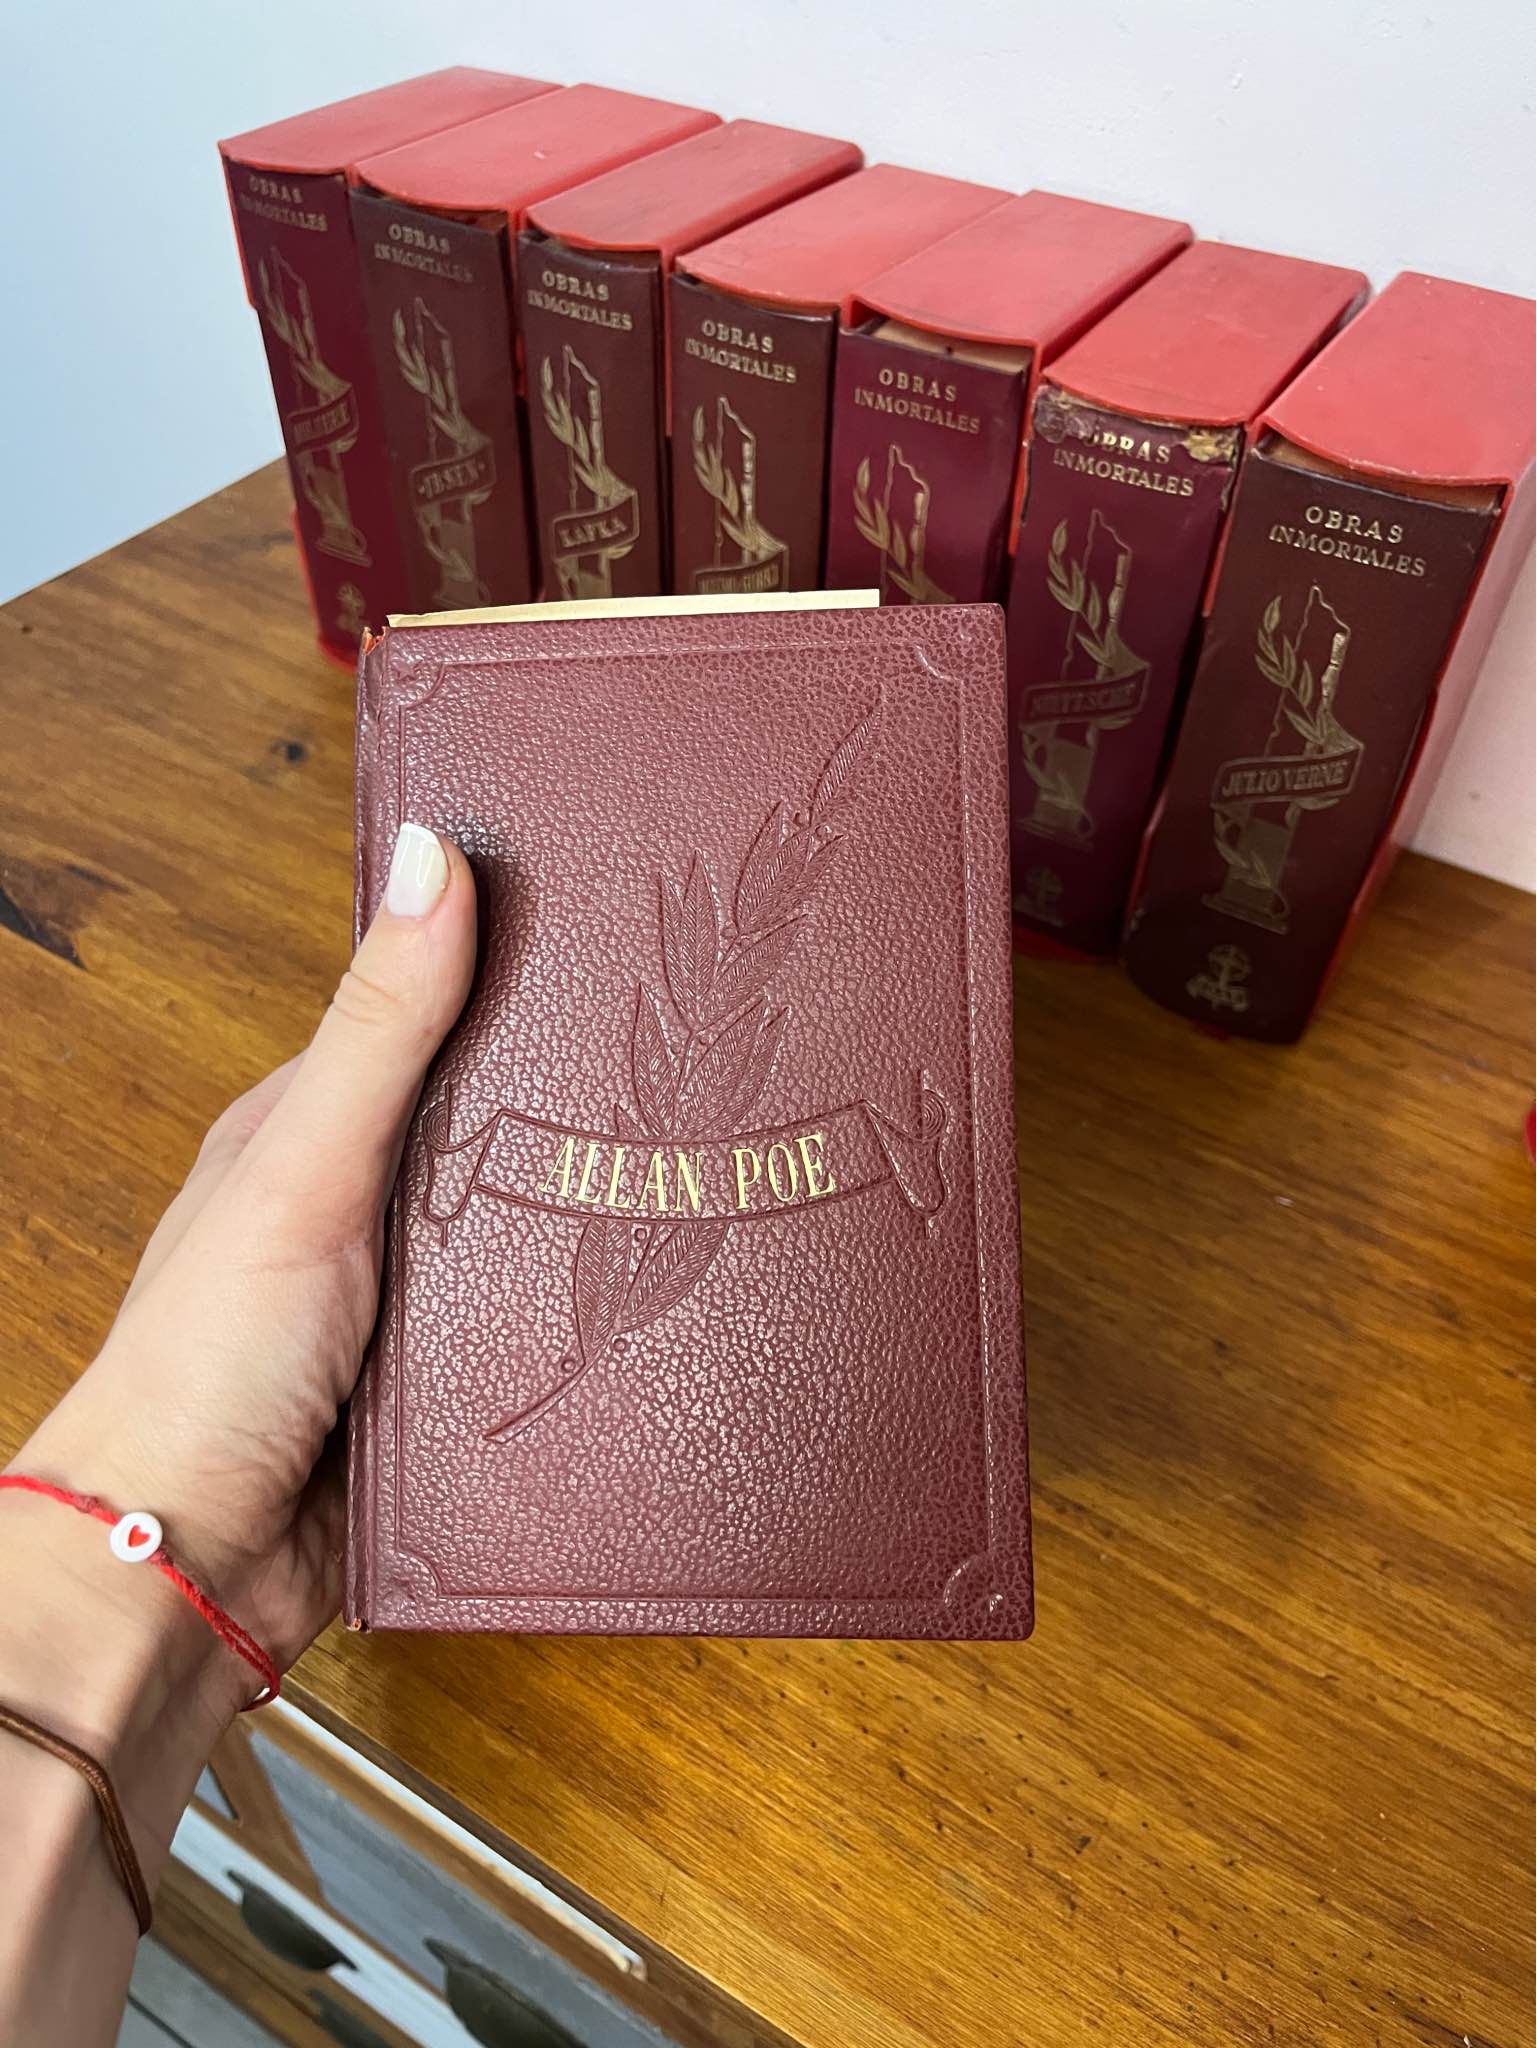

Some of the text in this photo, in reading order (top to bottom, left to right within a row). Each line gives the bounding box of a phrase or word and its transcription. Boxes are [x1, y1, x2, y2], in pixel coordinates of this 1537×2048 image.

[388, 223, 451, 255] OBRAS
[541, 269, 609, 301] OBRAS
[527, 289, 633, 331] INMORTALES
[702, 319, 773, 354] OBRAS
[685, 337, 797, 384] INMORTALES
[878, 367, 957, 402] OBRAS
[854, 387, 980, 435] INMORTALES
[1053, 447, 1195, 498] INMORTALES
[558, 515, 628, 548] KAFKA
[1304, 505, 1404, 545] OBRAS
[1268, 524, 1427, 578] INMORTALES
[1221, 760, 1348, 797] JULIO VERNE
[539, 1130, 836, 1213] ALLAN POE
